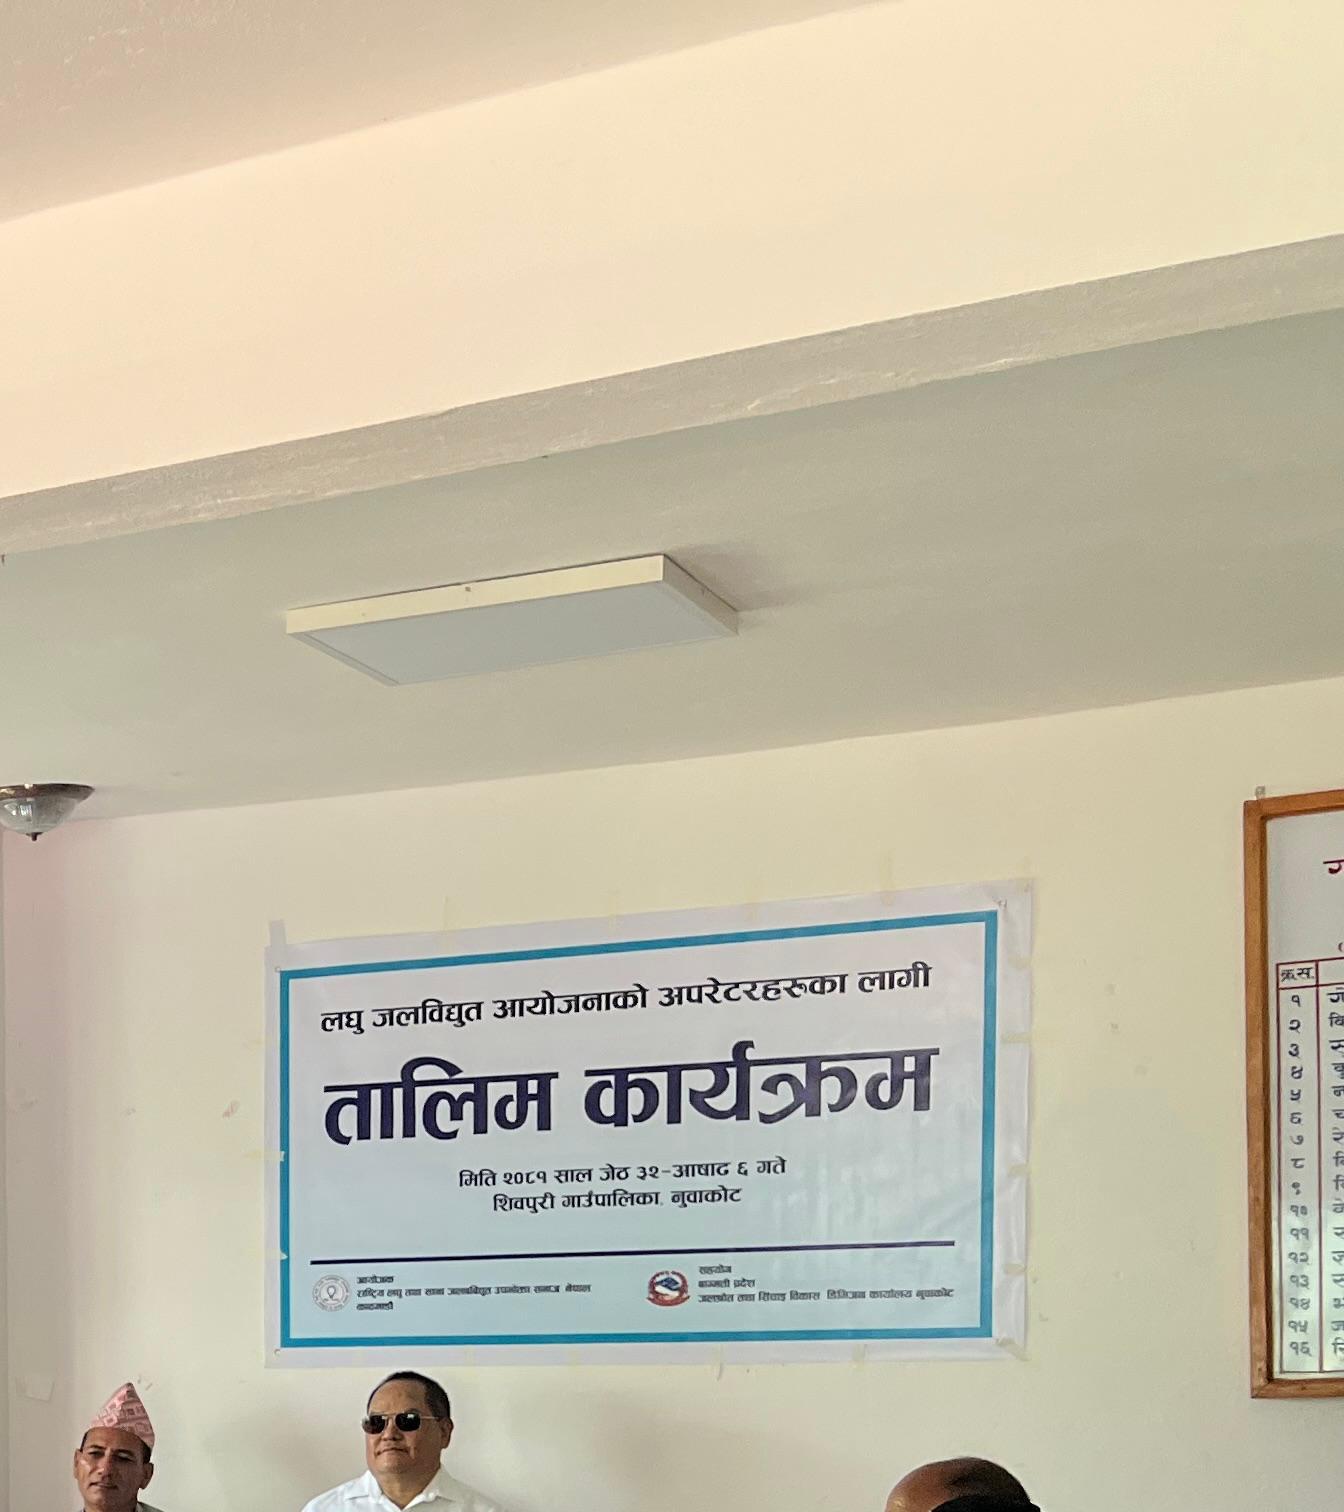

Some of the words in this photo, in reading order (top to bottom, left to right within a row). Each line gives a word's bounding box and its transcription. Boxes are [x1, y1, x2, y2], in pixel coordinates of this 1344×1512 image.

[321, 1010, 364, 1034] लघु
[493, 983, 649, 1019] आयोजनाको
[858, 961, 932, 993] लागी
[324, 1056, 559, 1145] तालिम
[584, 1040, 940, 1128] कार्यक्रम
[459, 1168, 497, 1187] मिति
[503, 1170, 547, 1185] २०८१
[554, 1167, 593, 1183] साल
[599, 1163, 630, 1181] जेठ
[737, 1161, 748, 1176] ६
[756, 1155, 787, 1174] गते
[493, 1192, 555, 1213] शिवपुरी
[670, 1184, 742, 1208] नुवाकोट
